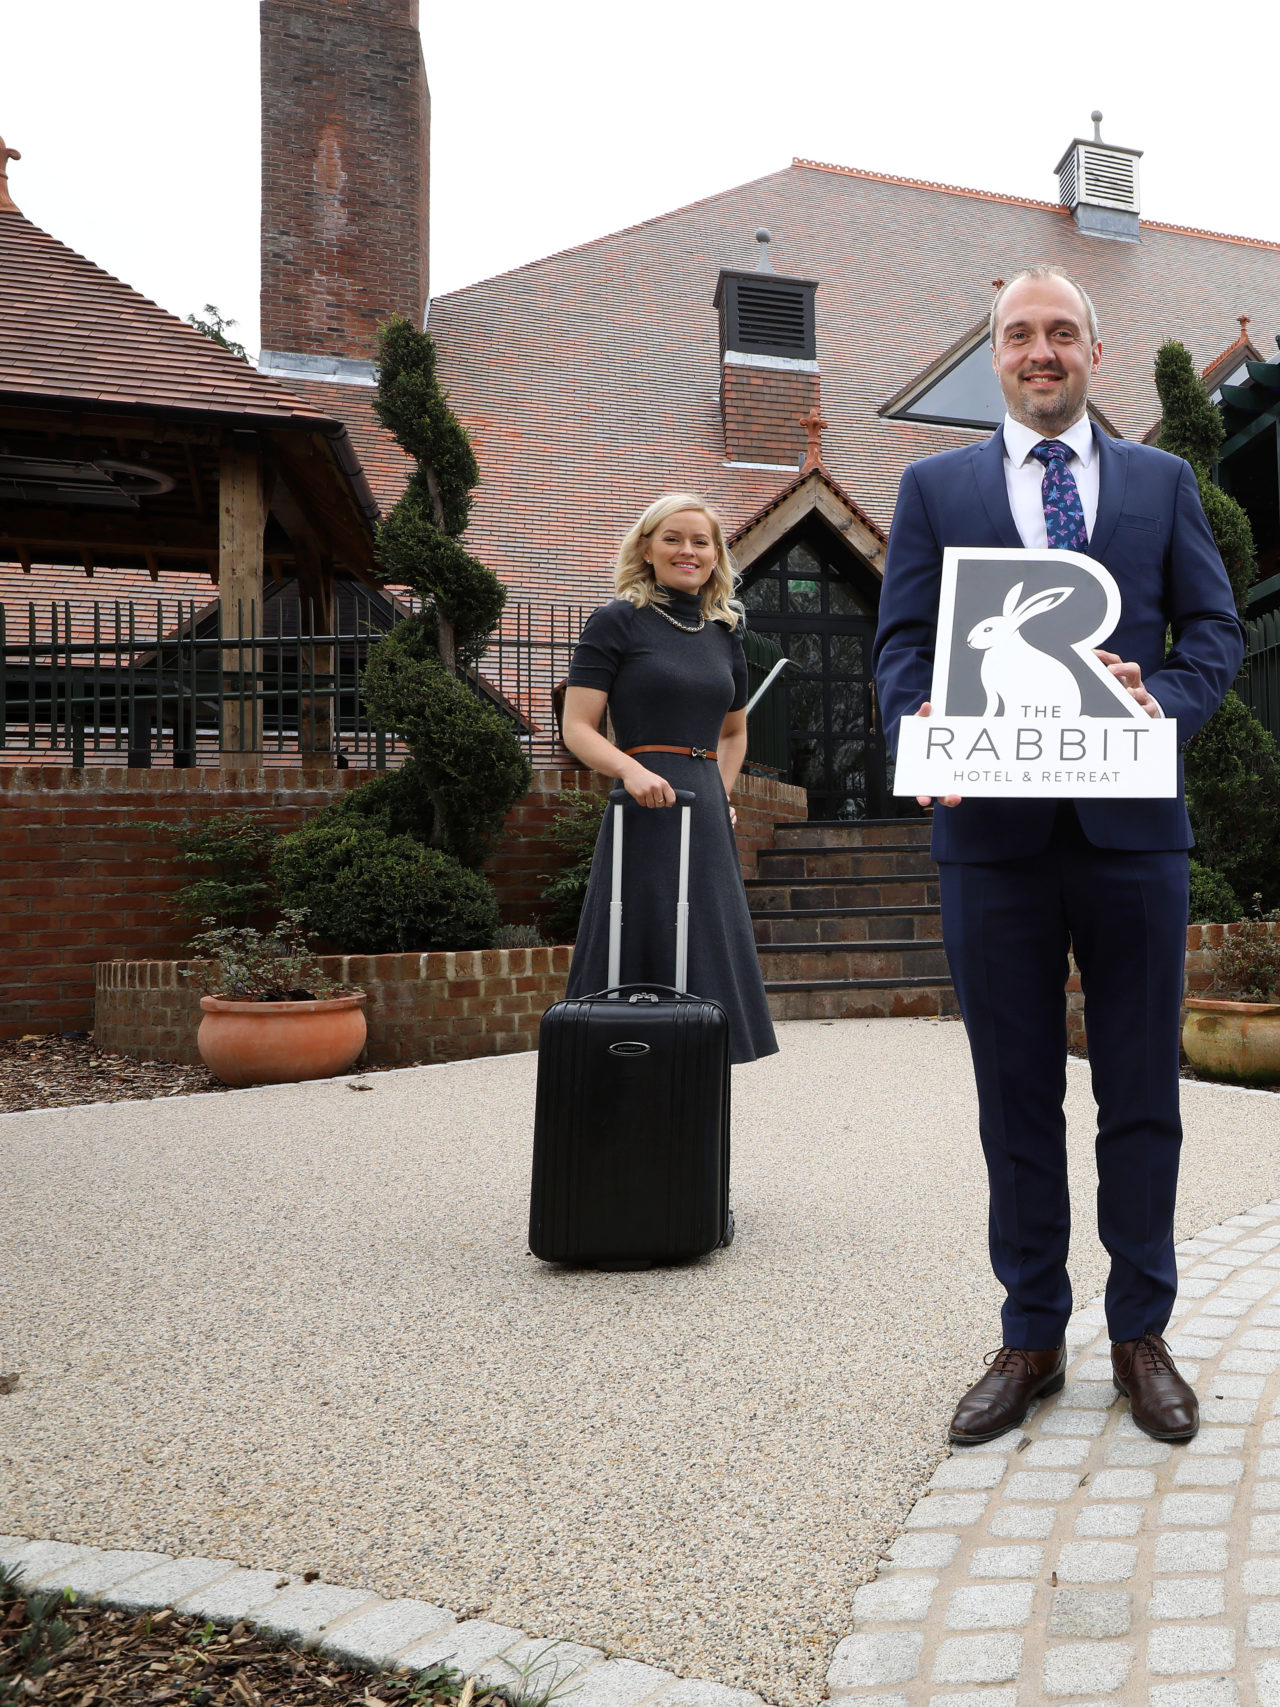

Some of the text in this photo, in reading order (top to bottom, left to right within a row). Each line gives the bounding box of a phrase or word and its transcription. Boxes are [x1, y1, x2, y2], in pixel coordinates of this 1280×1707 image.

[1020, 705, 1062, 719] THE
[926, 727, 1150, 761] RABBIT
[953, 770, 1121, 783] HOTEL & RETREAT
